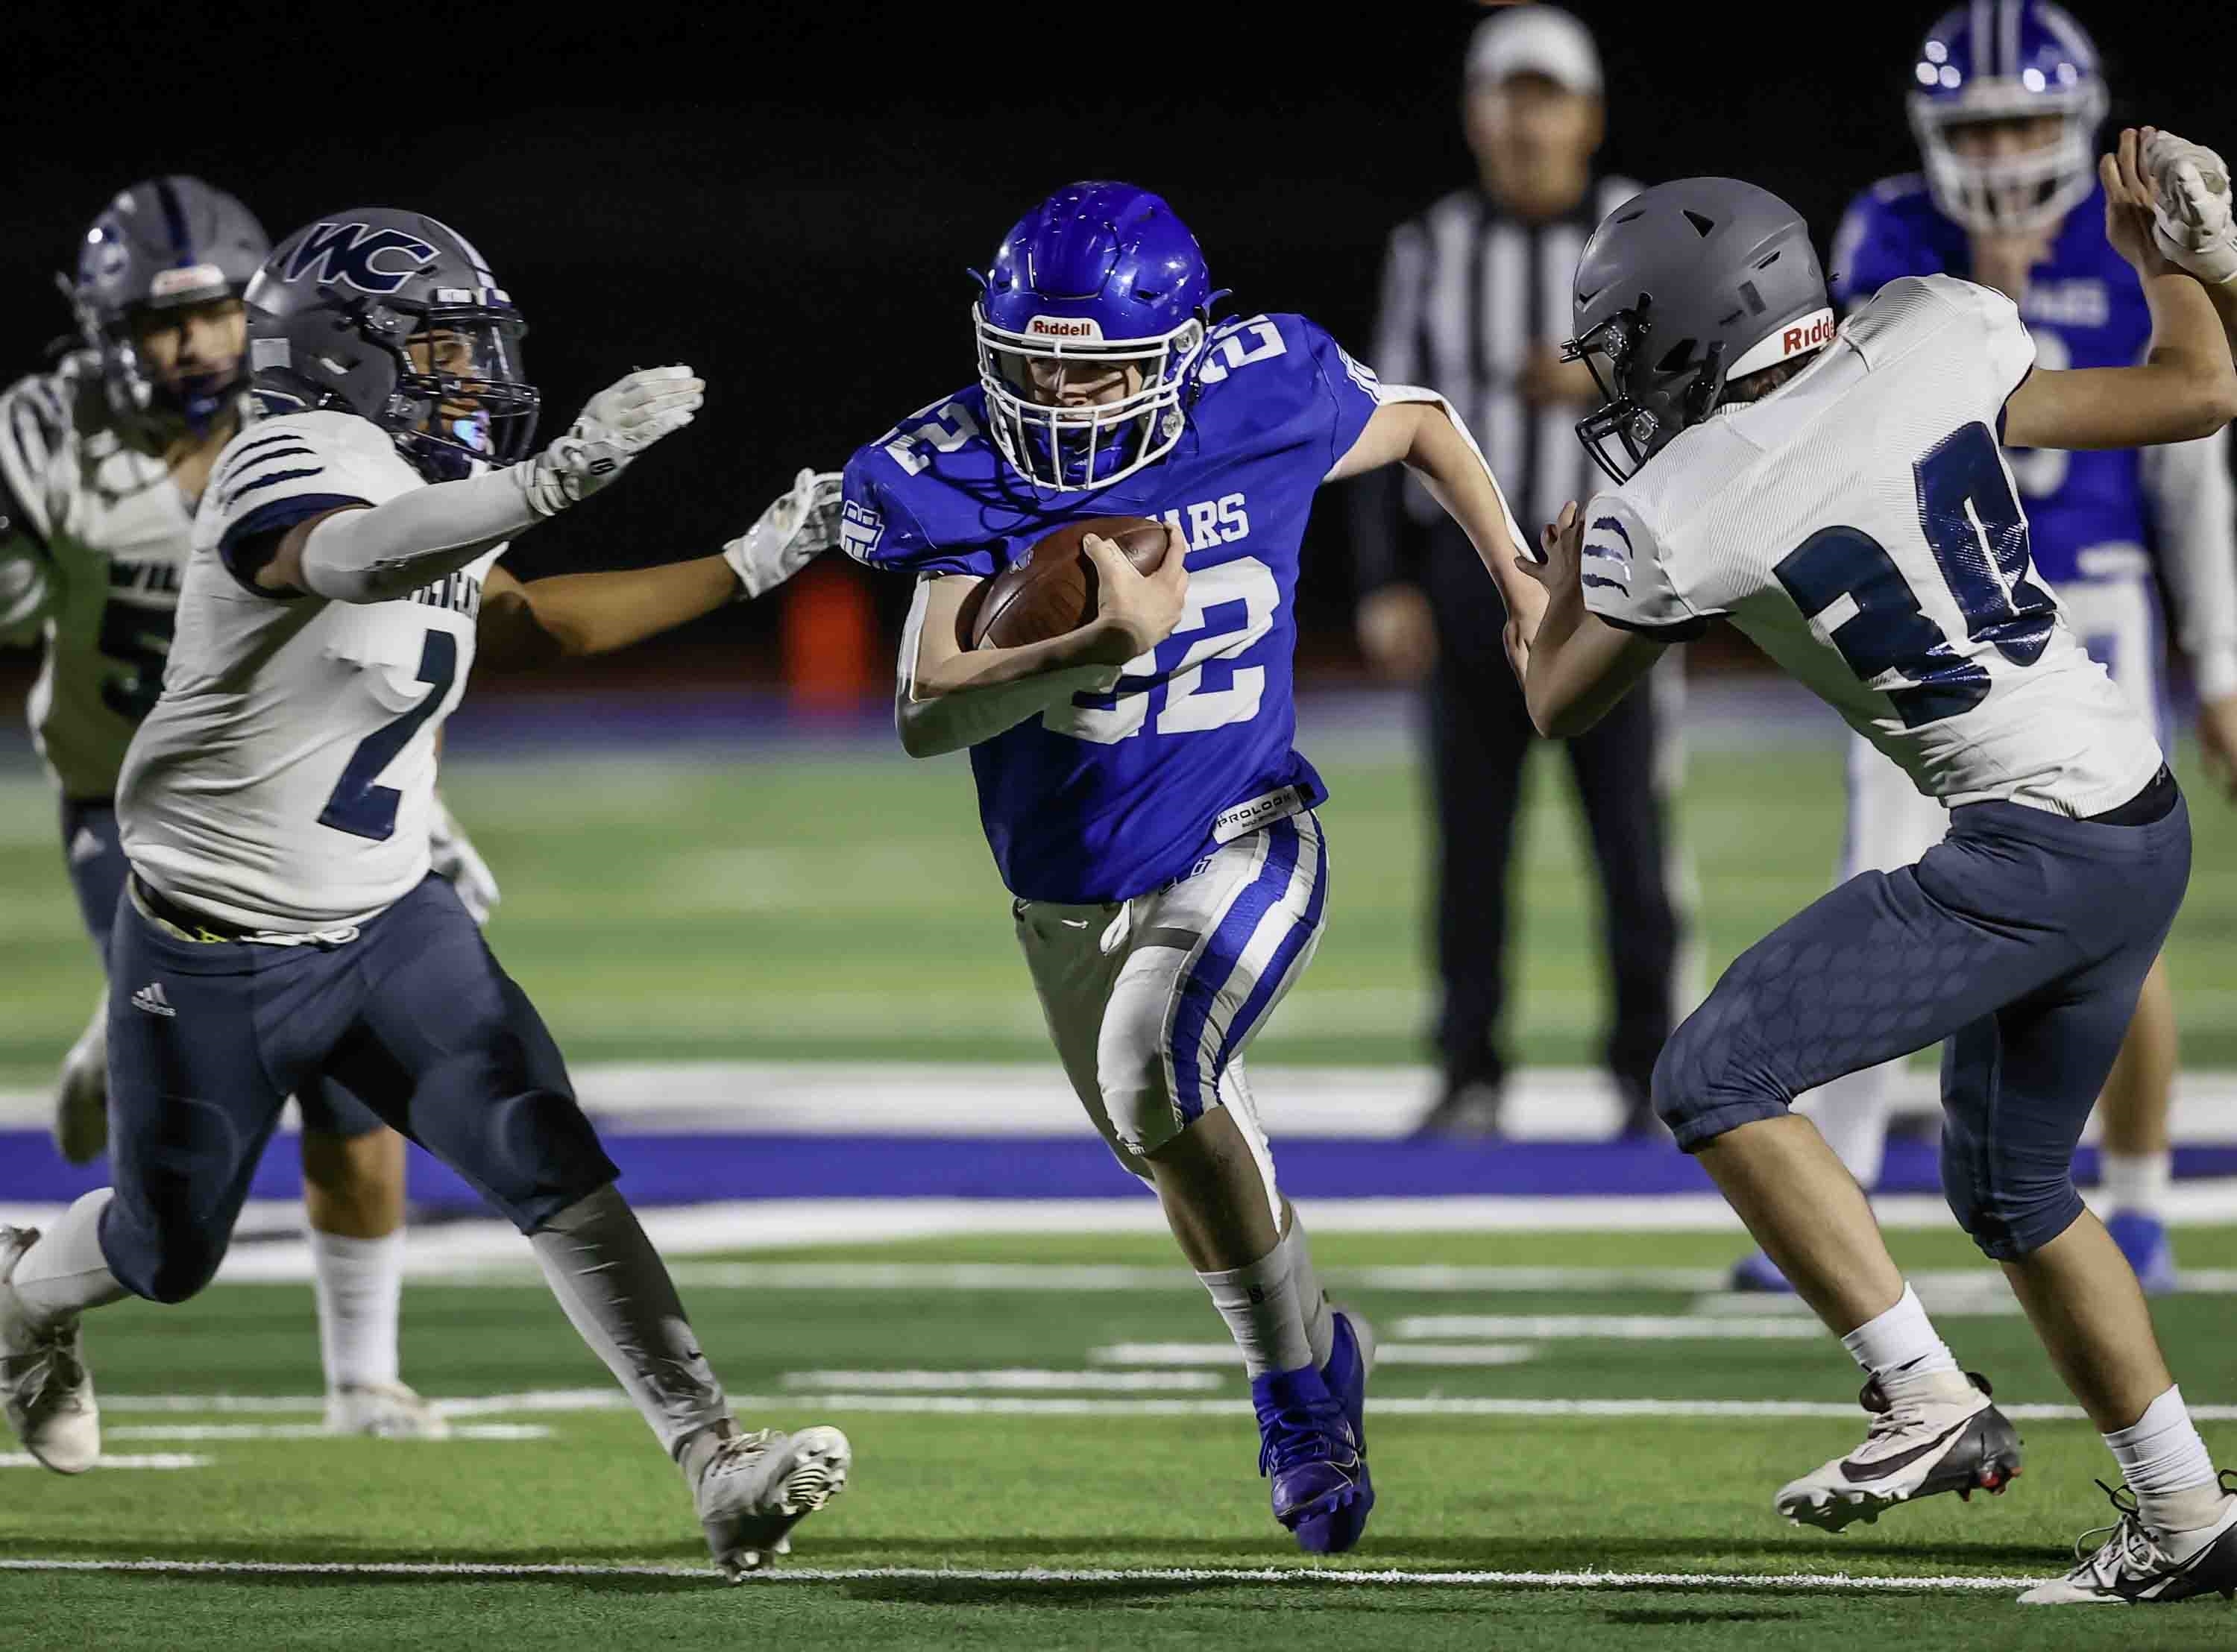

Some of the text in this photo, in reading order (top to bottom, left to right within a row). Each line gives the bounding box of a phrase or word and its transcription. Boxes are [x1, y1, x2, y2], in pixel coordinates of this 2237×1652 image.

[283, 223, 442, 293] WC
[1033, 321, 1091, 335] Riddell
[318, 628, 457, 842] 2
